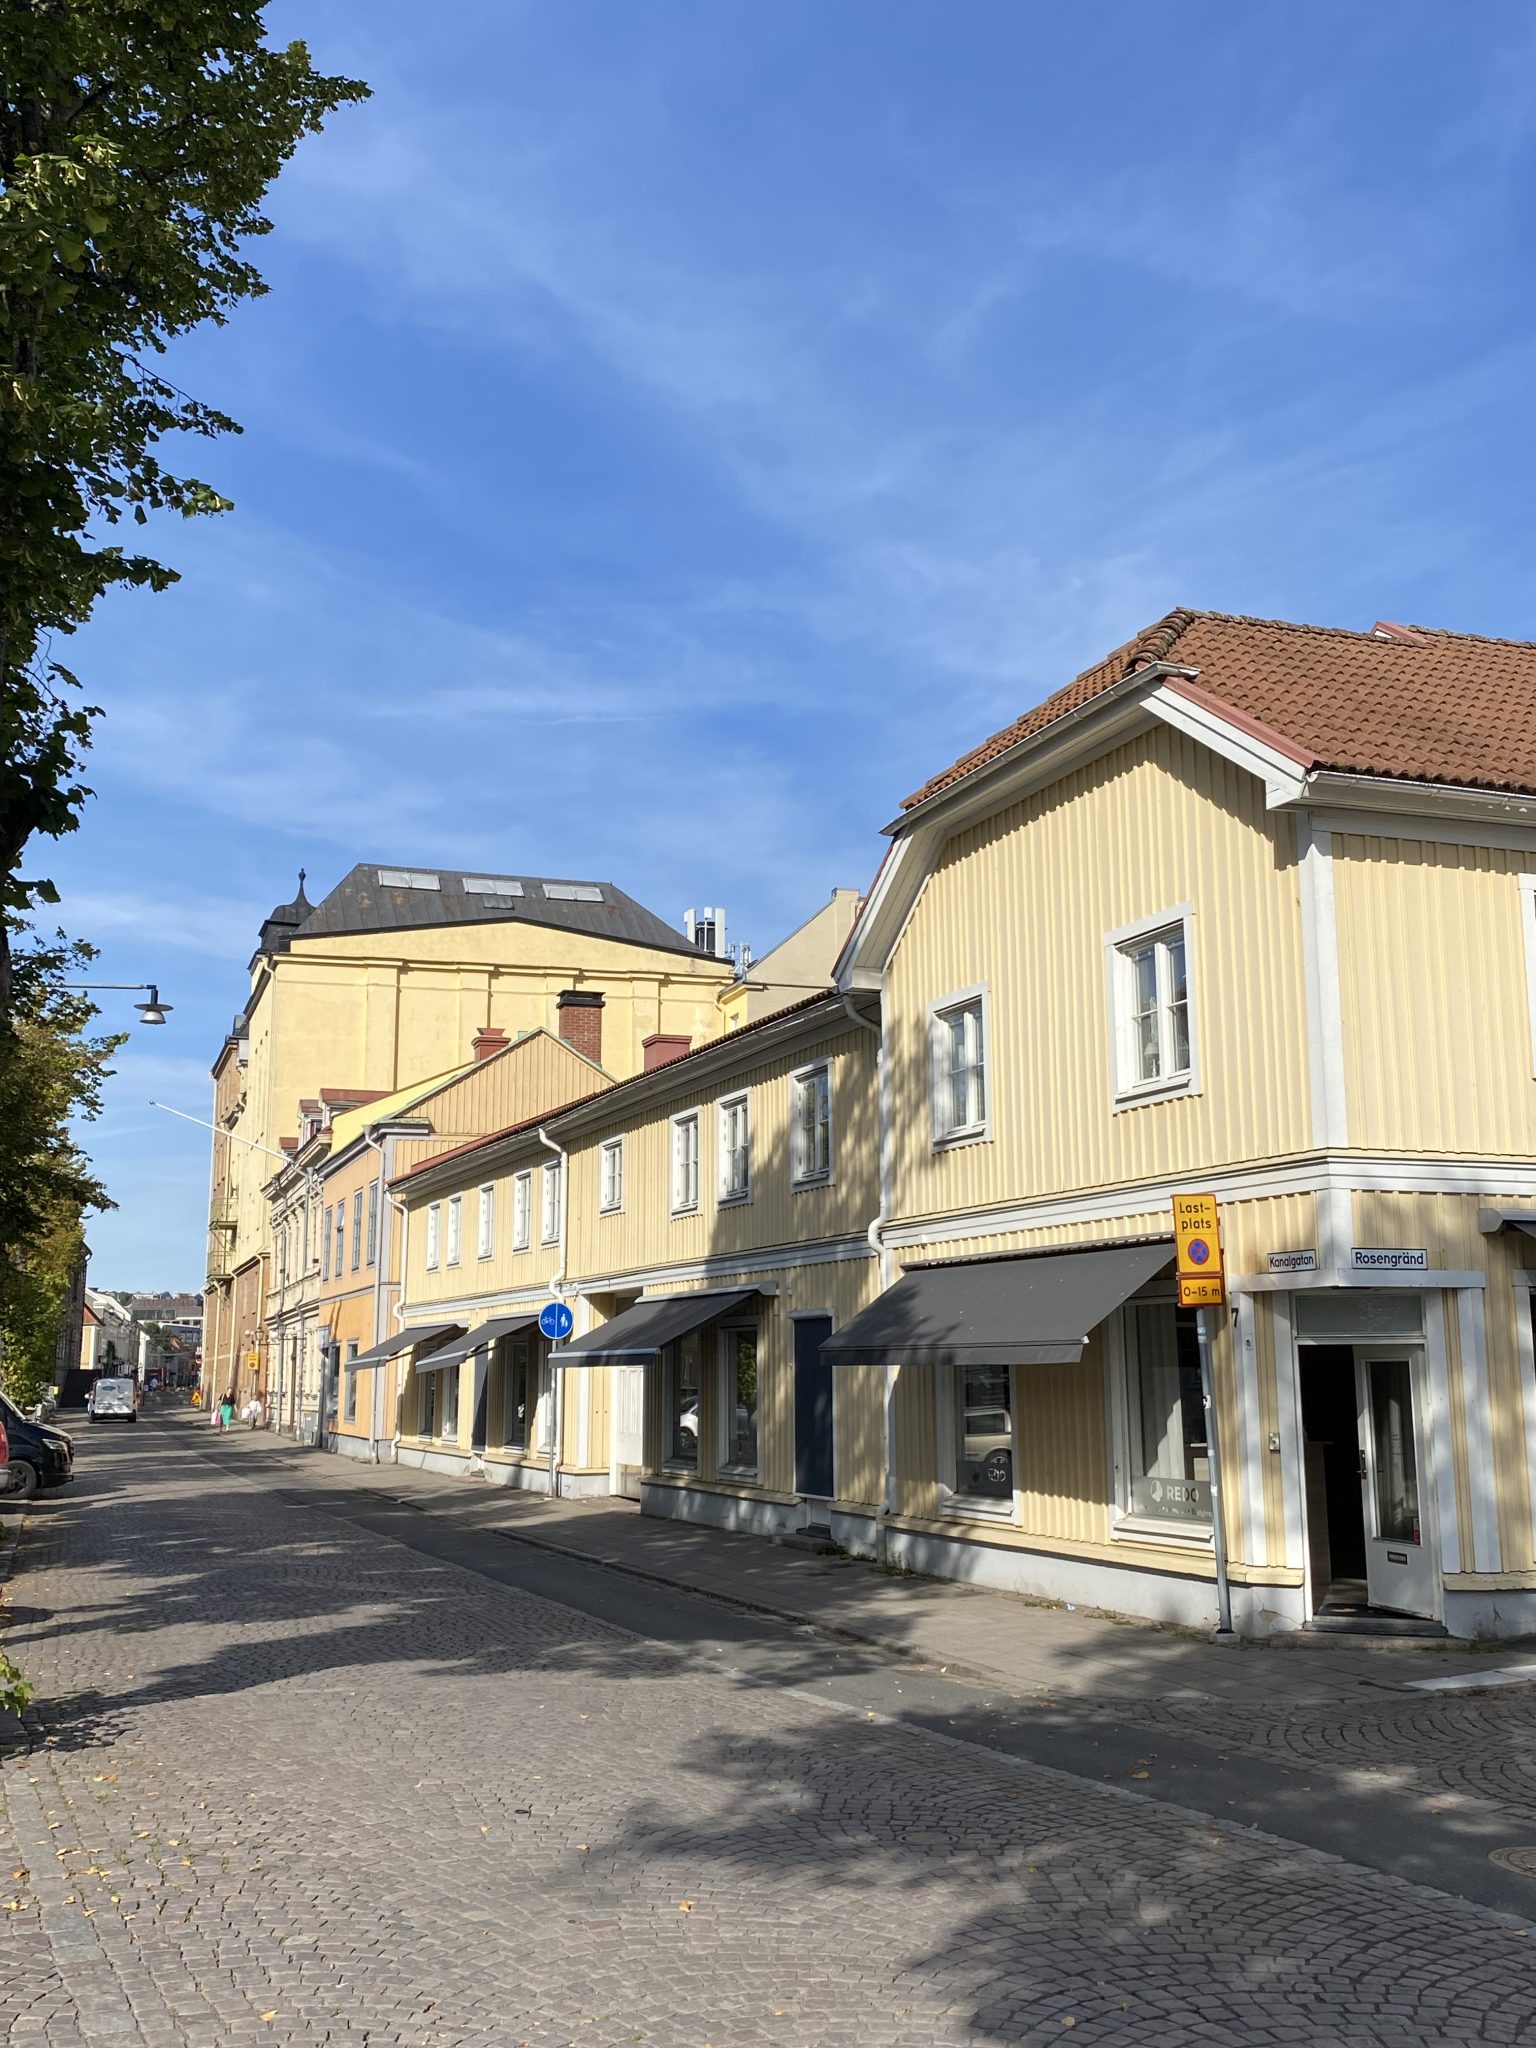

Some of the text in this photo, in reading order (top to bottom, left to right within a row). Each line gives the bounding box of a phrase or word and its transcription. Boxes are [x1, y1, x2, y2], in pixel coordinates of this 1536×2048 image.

[1179, 1202, 1211, 1214] Last-
[1181, 1218, 1212, 1232] plats
[1269, 1254, 1314, 1269] Kanalgatan
[1355, 1251, 1424, 1267] Rosengränd
[1183, 1286, 1220, 1297] 0-15 m
[1230, 1307, 1239, 1328] 7
